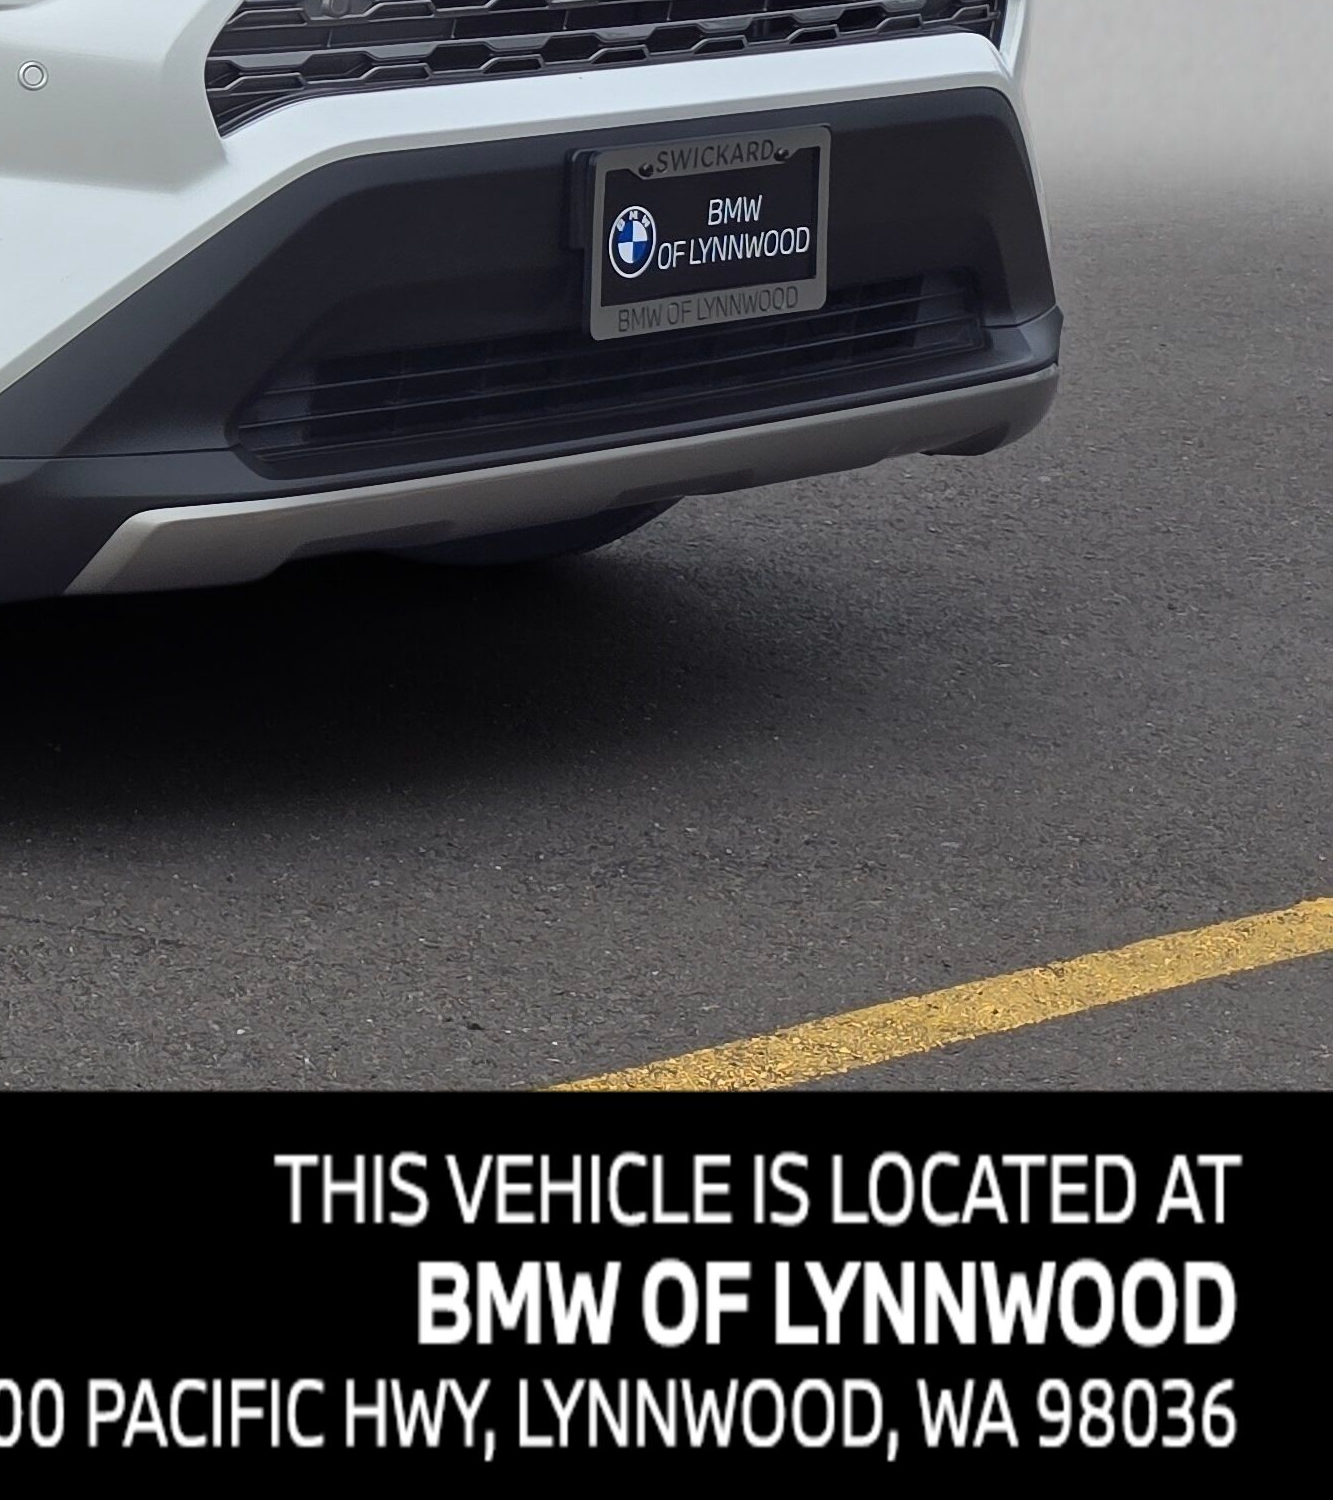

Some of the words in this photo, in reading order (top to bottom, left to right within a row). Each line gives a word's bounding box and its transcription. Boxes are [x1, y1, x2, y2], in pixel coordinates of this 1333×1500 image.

[656, 139, 774, 174] SWICKARD
[707, 194, 763, 226] BMW
[657, 240, 686, 270] OF
[689, 226, 811, 265] LYNNWOOD
[618, 304, 663, 332] BMW
[667, 299, 692, 325] OF
[696, 285, 799, 322] LYNNWOOD
